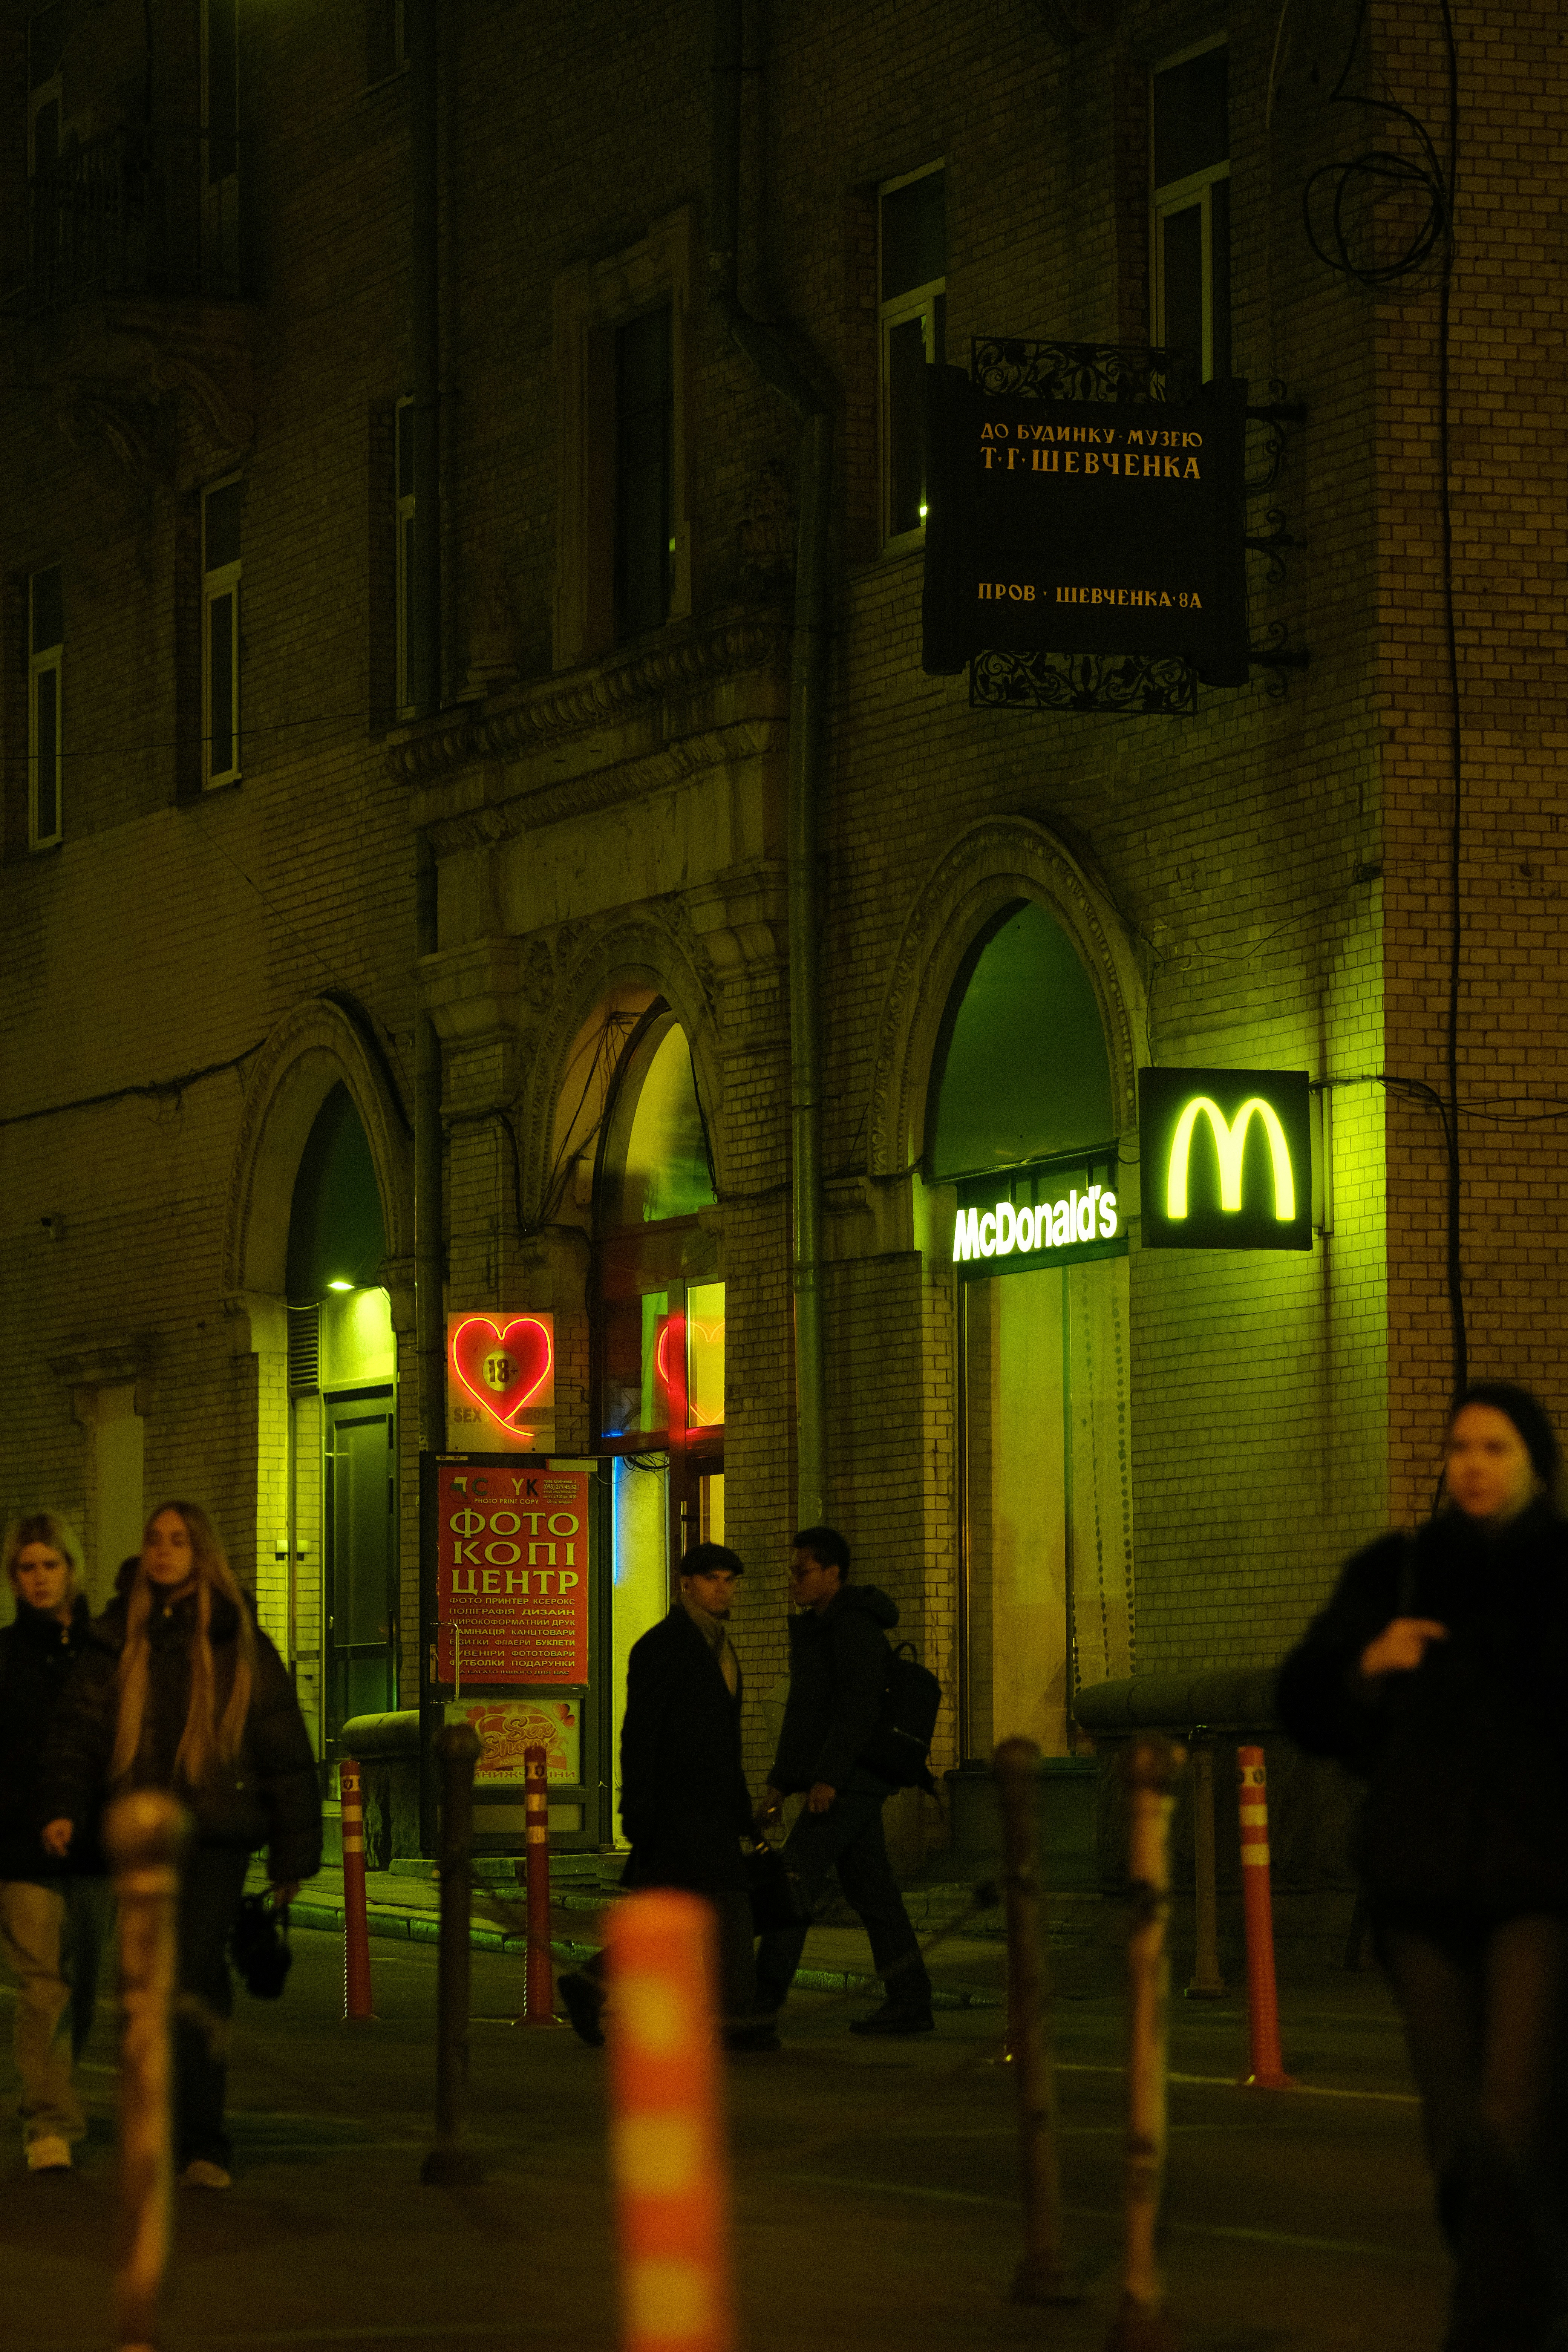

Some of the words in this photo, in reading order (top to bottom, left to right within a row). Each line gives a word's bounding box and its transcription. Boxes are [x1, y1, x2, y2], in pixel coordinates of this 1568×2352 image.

[981, 423, 1009, 440] ДО
[952, 1184, 1118, 1262] McDonald's
[488, 1358, 518, 1383] 18+
[454, 1407, 482, 1423] SEX
[449, 1508, 579, 1539] ФОТО
[453, 1541, 576, 1566] КОПІ
[452, 1569, 579, 1596] ЦЕНТР
[503, 1715, 557, 1741] Sex
